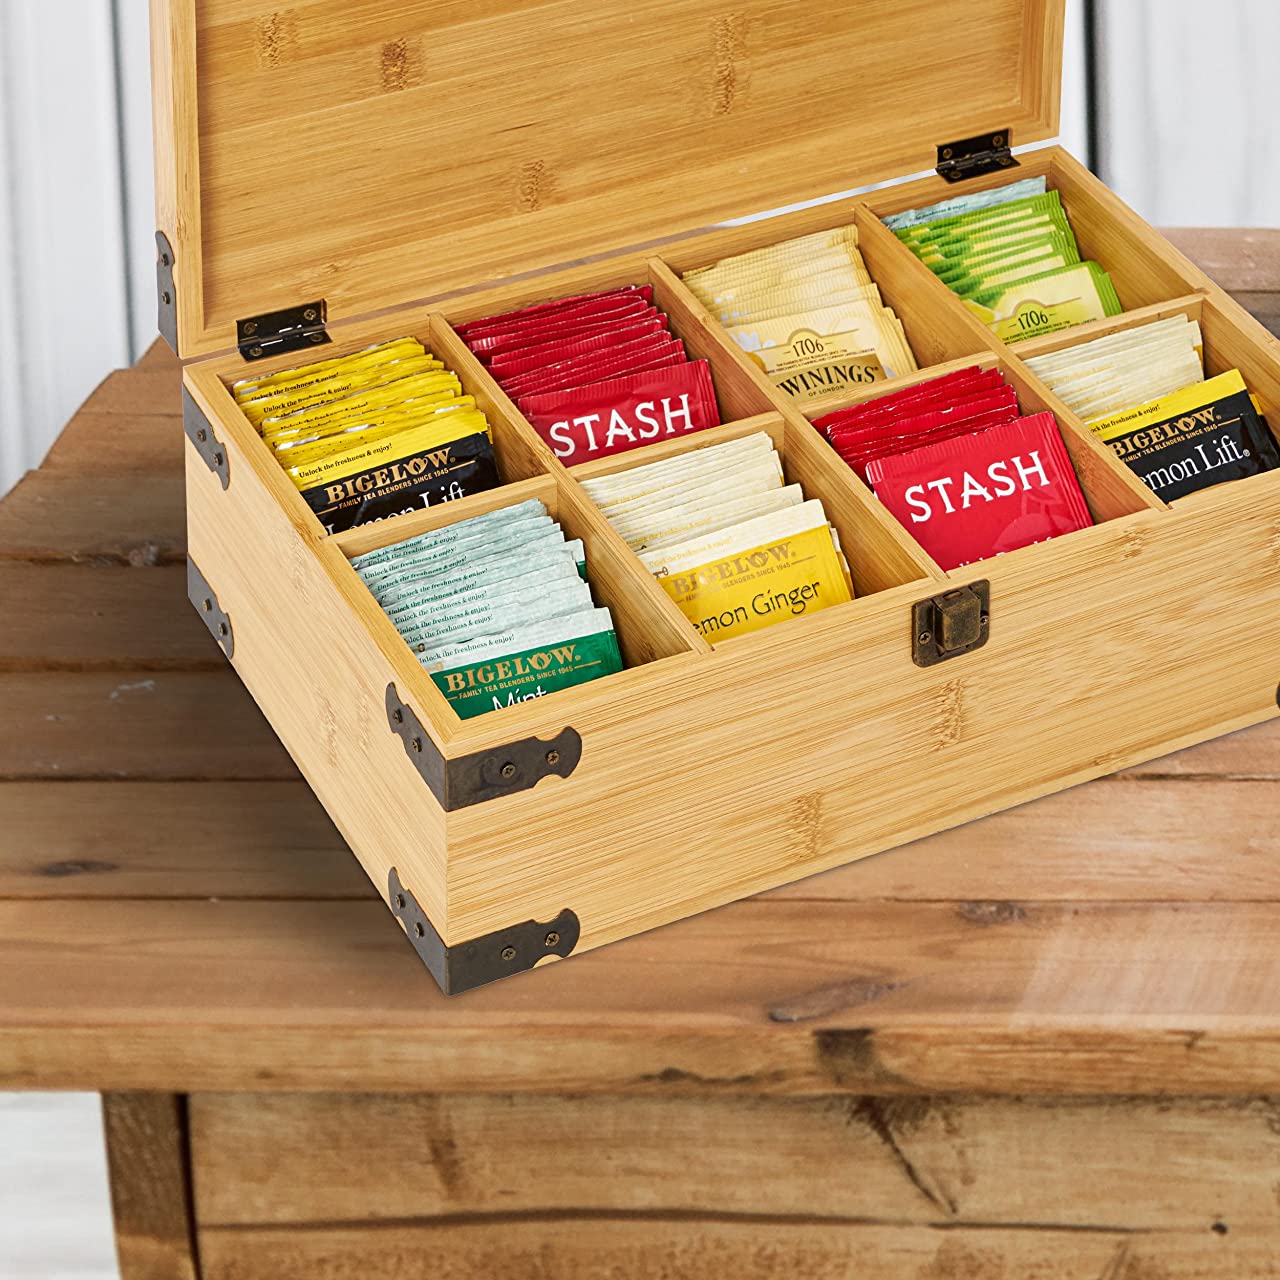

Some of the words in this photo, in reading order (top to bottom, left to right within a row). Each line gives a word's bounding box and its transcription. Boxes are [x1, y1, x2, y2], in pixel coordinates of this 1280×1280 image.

[1018, 310, 1048, 330] 1706
[793, 338, 824, 357] 1706
[775, 365, 875, 397] WININGS
[819, 385, 845, 395] LONDON
[263, 401, 286, 413] Unlock
[286, 397, 298, 407] the
[1101, 420, 1110, 429] the
[1111, 414, 1138, 426] freshness
[1143, 404, 1160, 415] enjoy!
[550, 393, 694, 457] STASH
[1107, 406, 1215, 457] BIGELOW
[1144, 448, 1155, 456] TEA
[1155, 436, 1186, 451] BLENDERS
[1186, 429, 1203, 440] SINCE
[298, 466, 323, 478] Unlock
[324, 462, 334, 471] the
[334, 453, 366, 466] freshness
[372, 442, 392, 454] enjoy!
[324, 447, 452, 505] BIGELOW
[338, 496, 362, 509] FAMILY
[364, 492, 376, 500] TEA
[378, 480, 412, 496] BLENDERS
[413, 473, 432, 484] SINCE
[434, 468, 448, 478] 1945
[904, 450, 1050, 523] STASH
[364, 568, 388, 579] Unlock
[388, 564, 400, 572] the
[400, 556, 432, 568] freshness
[438, 546, 457, 556] enjoy!
[756, 568, 775, 578] SINCE
[777, 562, 791, 571] 1945
[378, 578, 398, 591] Unlock
[410, 567, 442, 579] freshness
[397, 590, 419, 600] Unlock
[431, 577, 462, 588] freshness
[394, 612, 418, 624] Unlock
[418, 608, 429, 616] the
[430, 599, 462, 612] freshness
[468, 591, 488, 601] enjoy!
[410, 600, 420, 608] the
[422, 592, 453, 604] freshness
[459, 581, 477, 592] enjoy!
[752, 582, 821, 615] Ginger
[421, 620, 431, 628] the
[432, 611, 464, 624] freshness
[470, 604, 491, 614] enjoy!
[425, 630, 435, 638] the
[436, 622, 467, 635] freshness
[454, 642, 488, 655] freshness
[494, 634, 514, 644] enjoy!
[444, 644, 577, 692] BIGELOW
[459, 688, 482, 700] FAMILY
[484, 685, 498, 693] TEA
[499, 675, 535, 689] BLENDERS
[536, 670, 557, 680] SINCE
